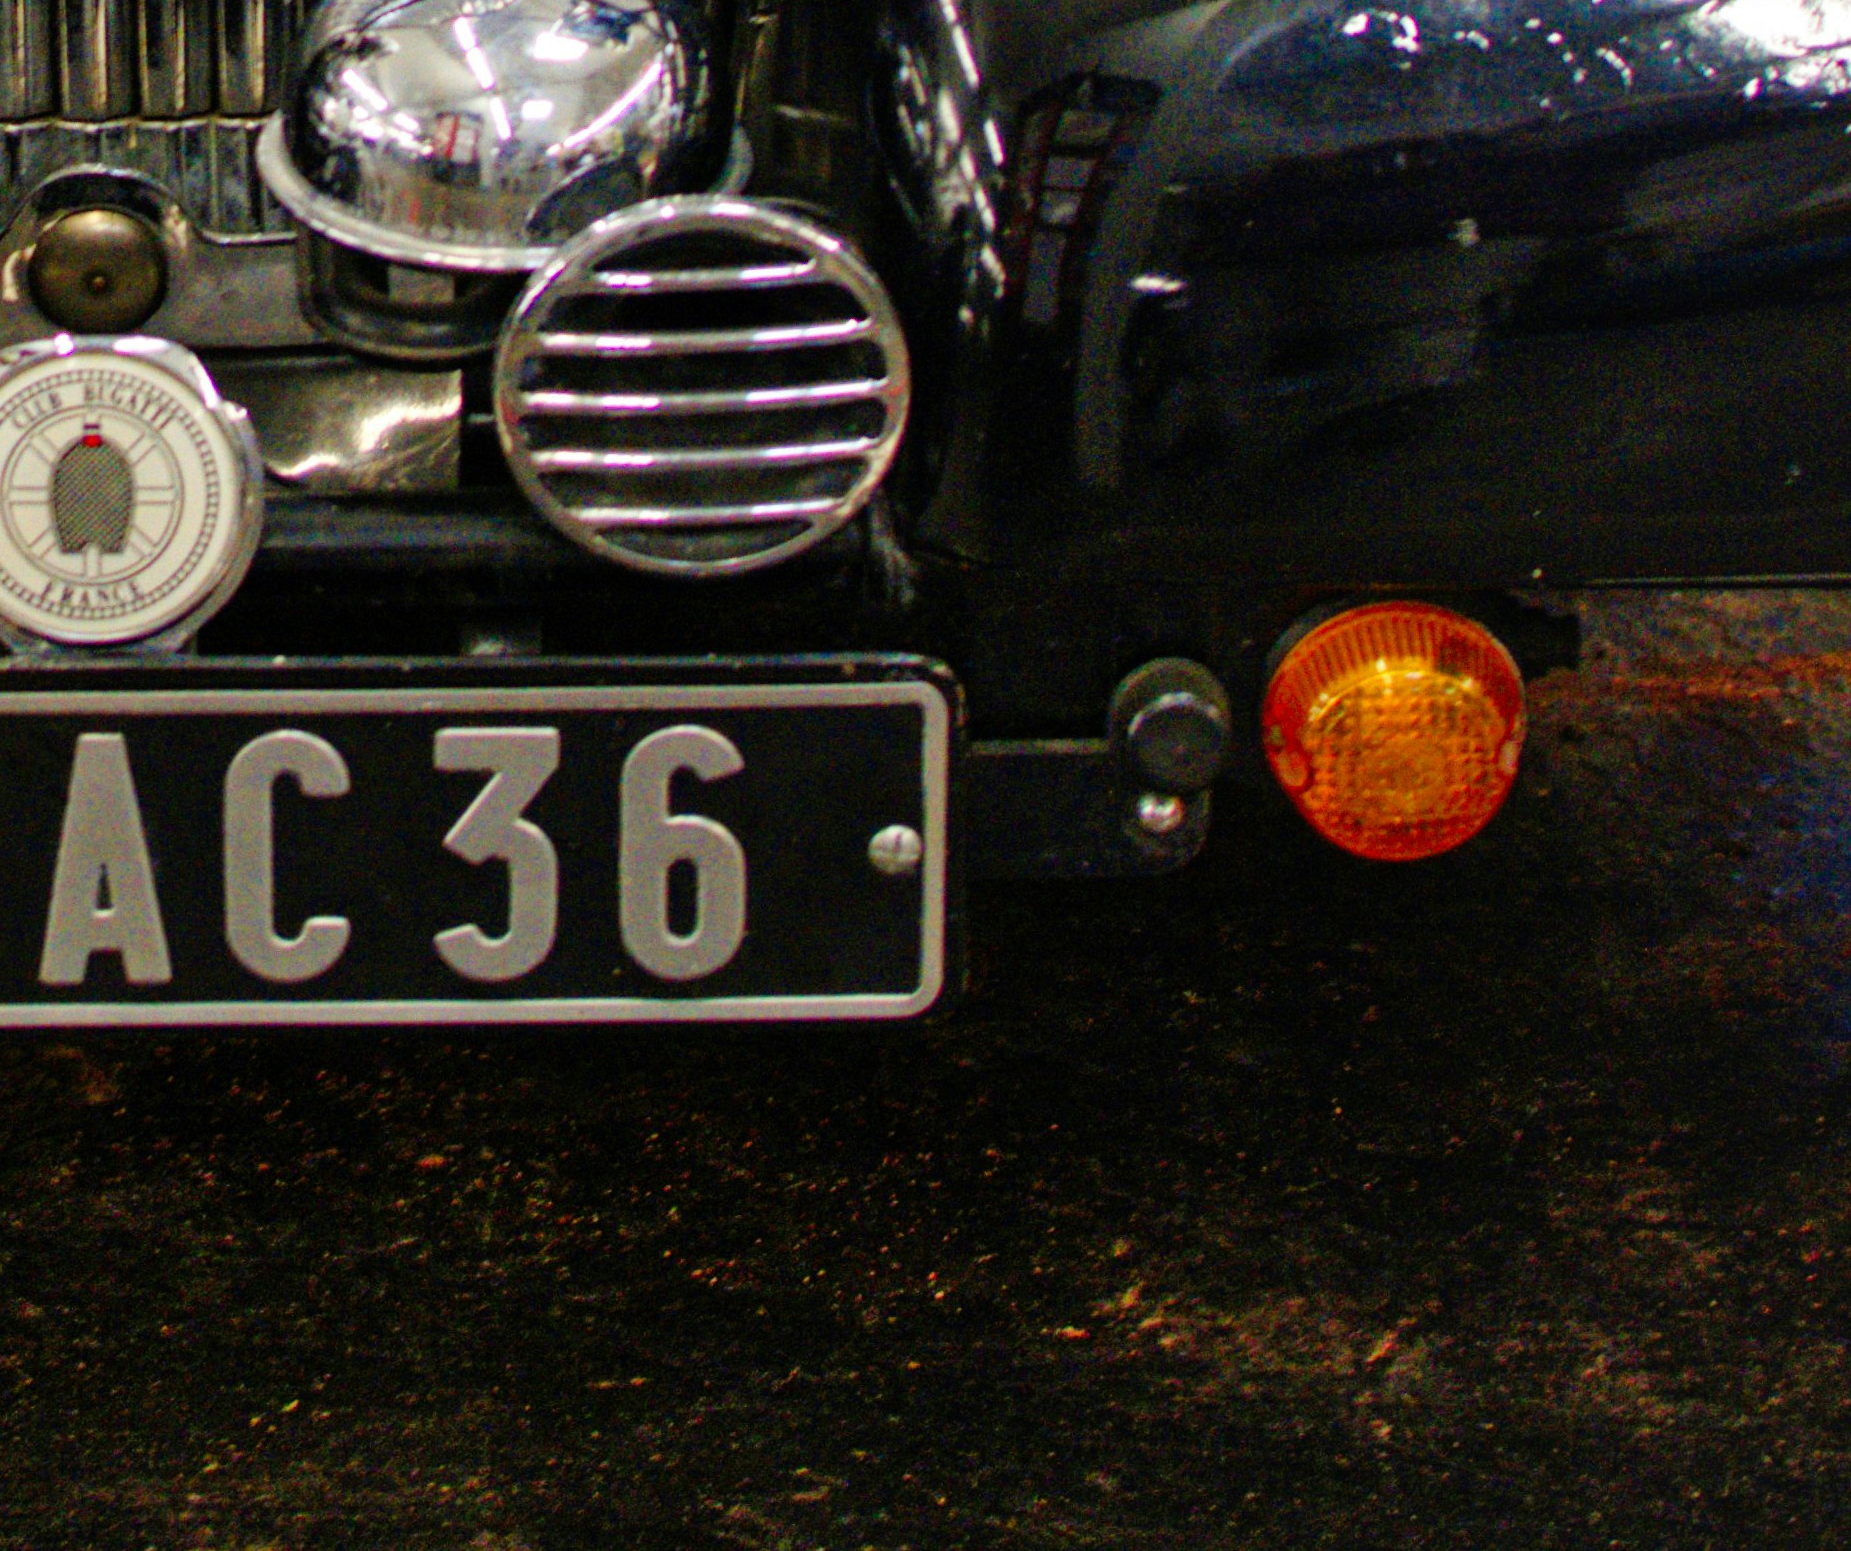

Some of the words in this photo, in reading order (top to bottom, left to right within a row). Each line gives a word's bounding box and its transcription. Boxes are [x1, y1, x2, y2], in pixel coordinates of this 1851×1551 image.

[12, 392, 63, 430] CLUB
[83, 383, 177, 430] BUGATTI
[40, 580, 146, 608] FRANCE
